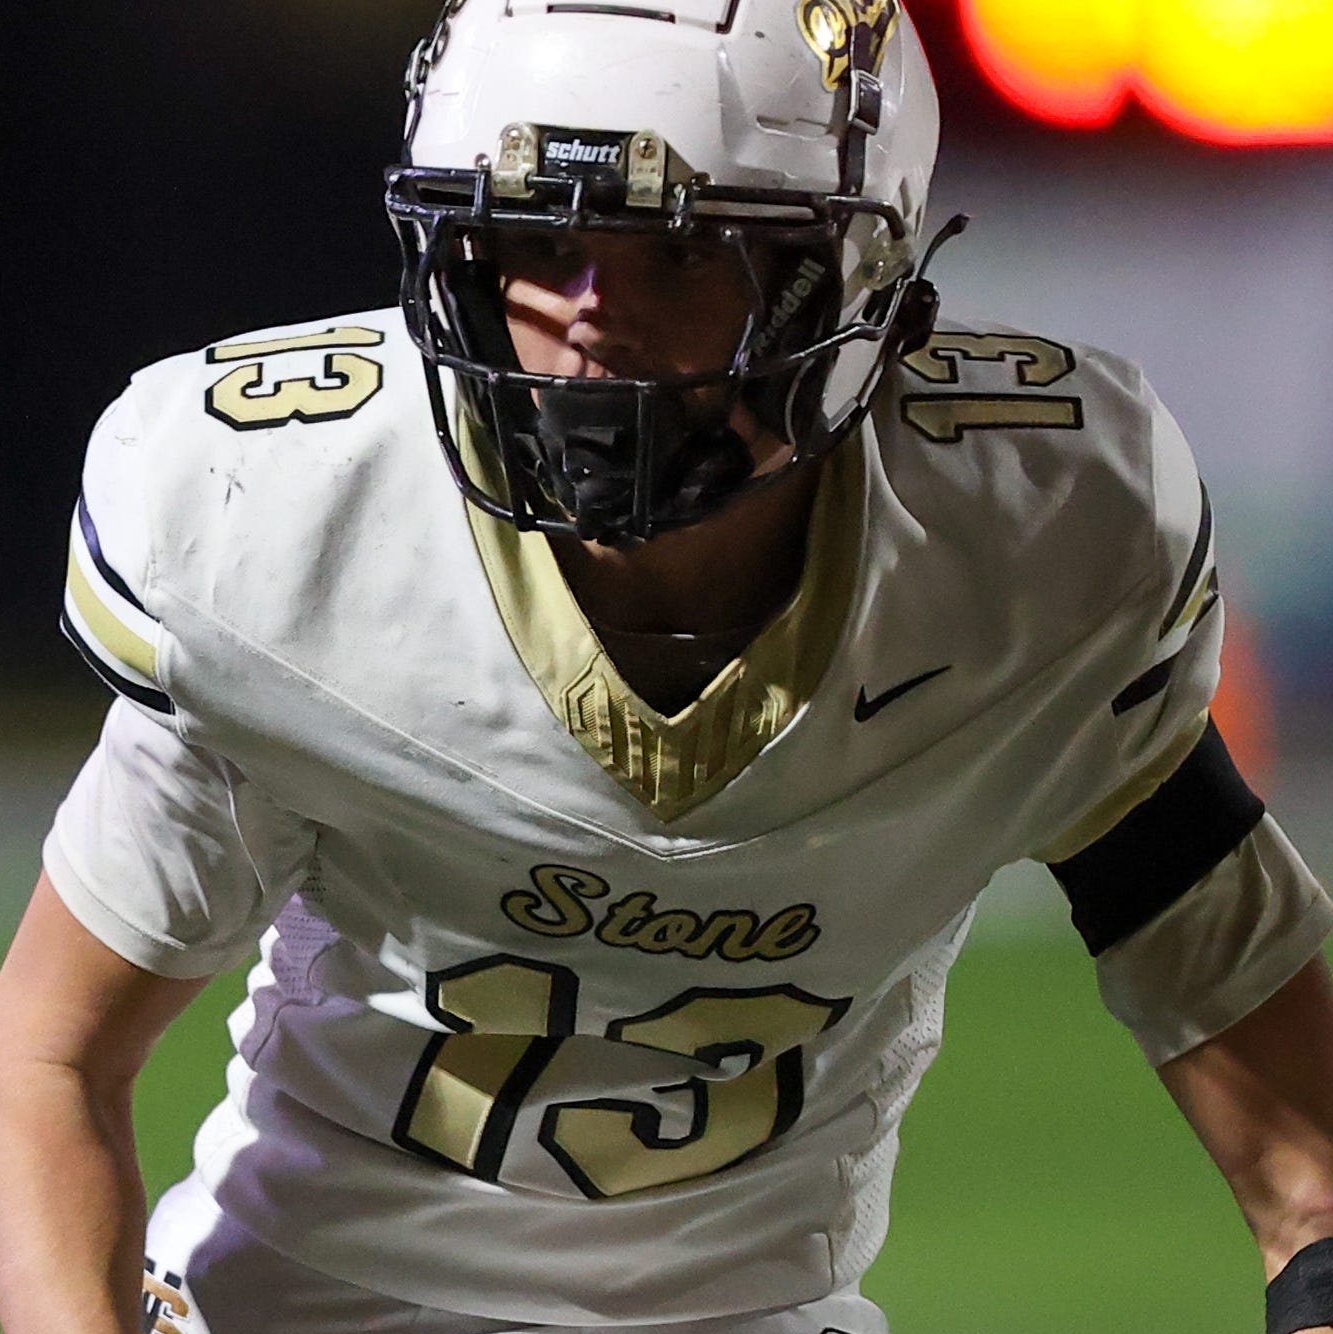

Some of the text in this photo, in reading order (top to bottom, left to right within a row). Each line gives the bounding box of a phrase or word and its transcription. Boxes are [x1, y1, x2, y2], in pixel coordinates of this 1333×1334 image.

[545, 138, 622, 164] schutt
[204, 325, 385, 432] 13
[897, 331, 1085, 443] 13
[499, 862, 822, 963] Stone
[390, 951, 854, 1200] 13
